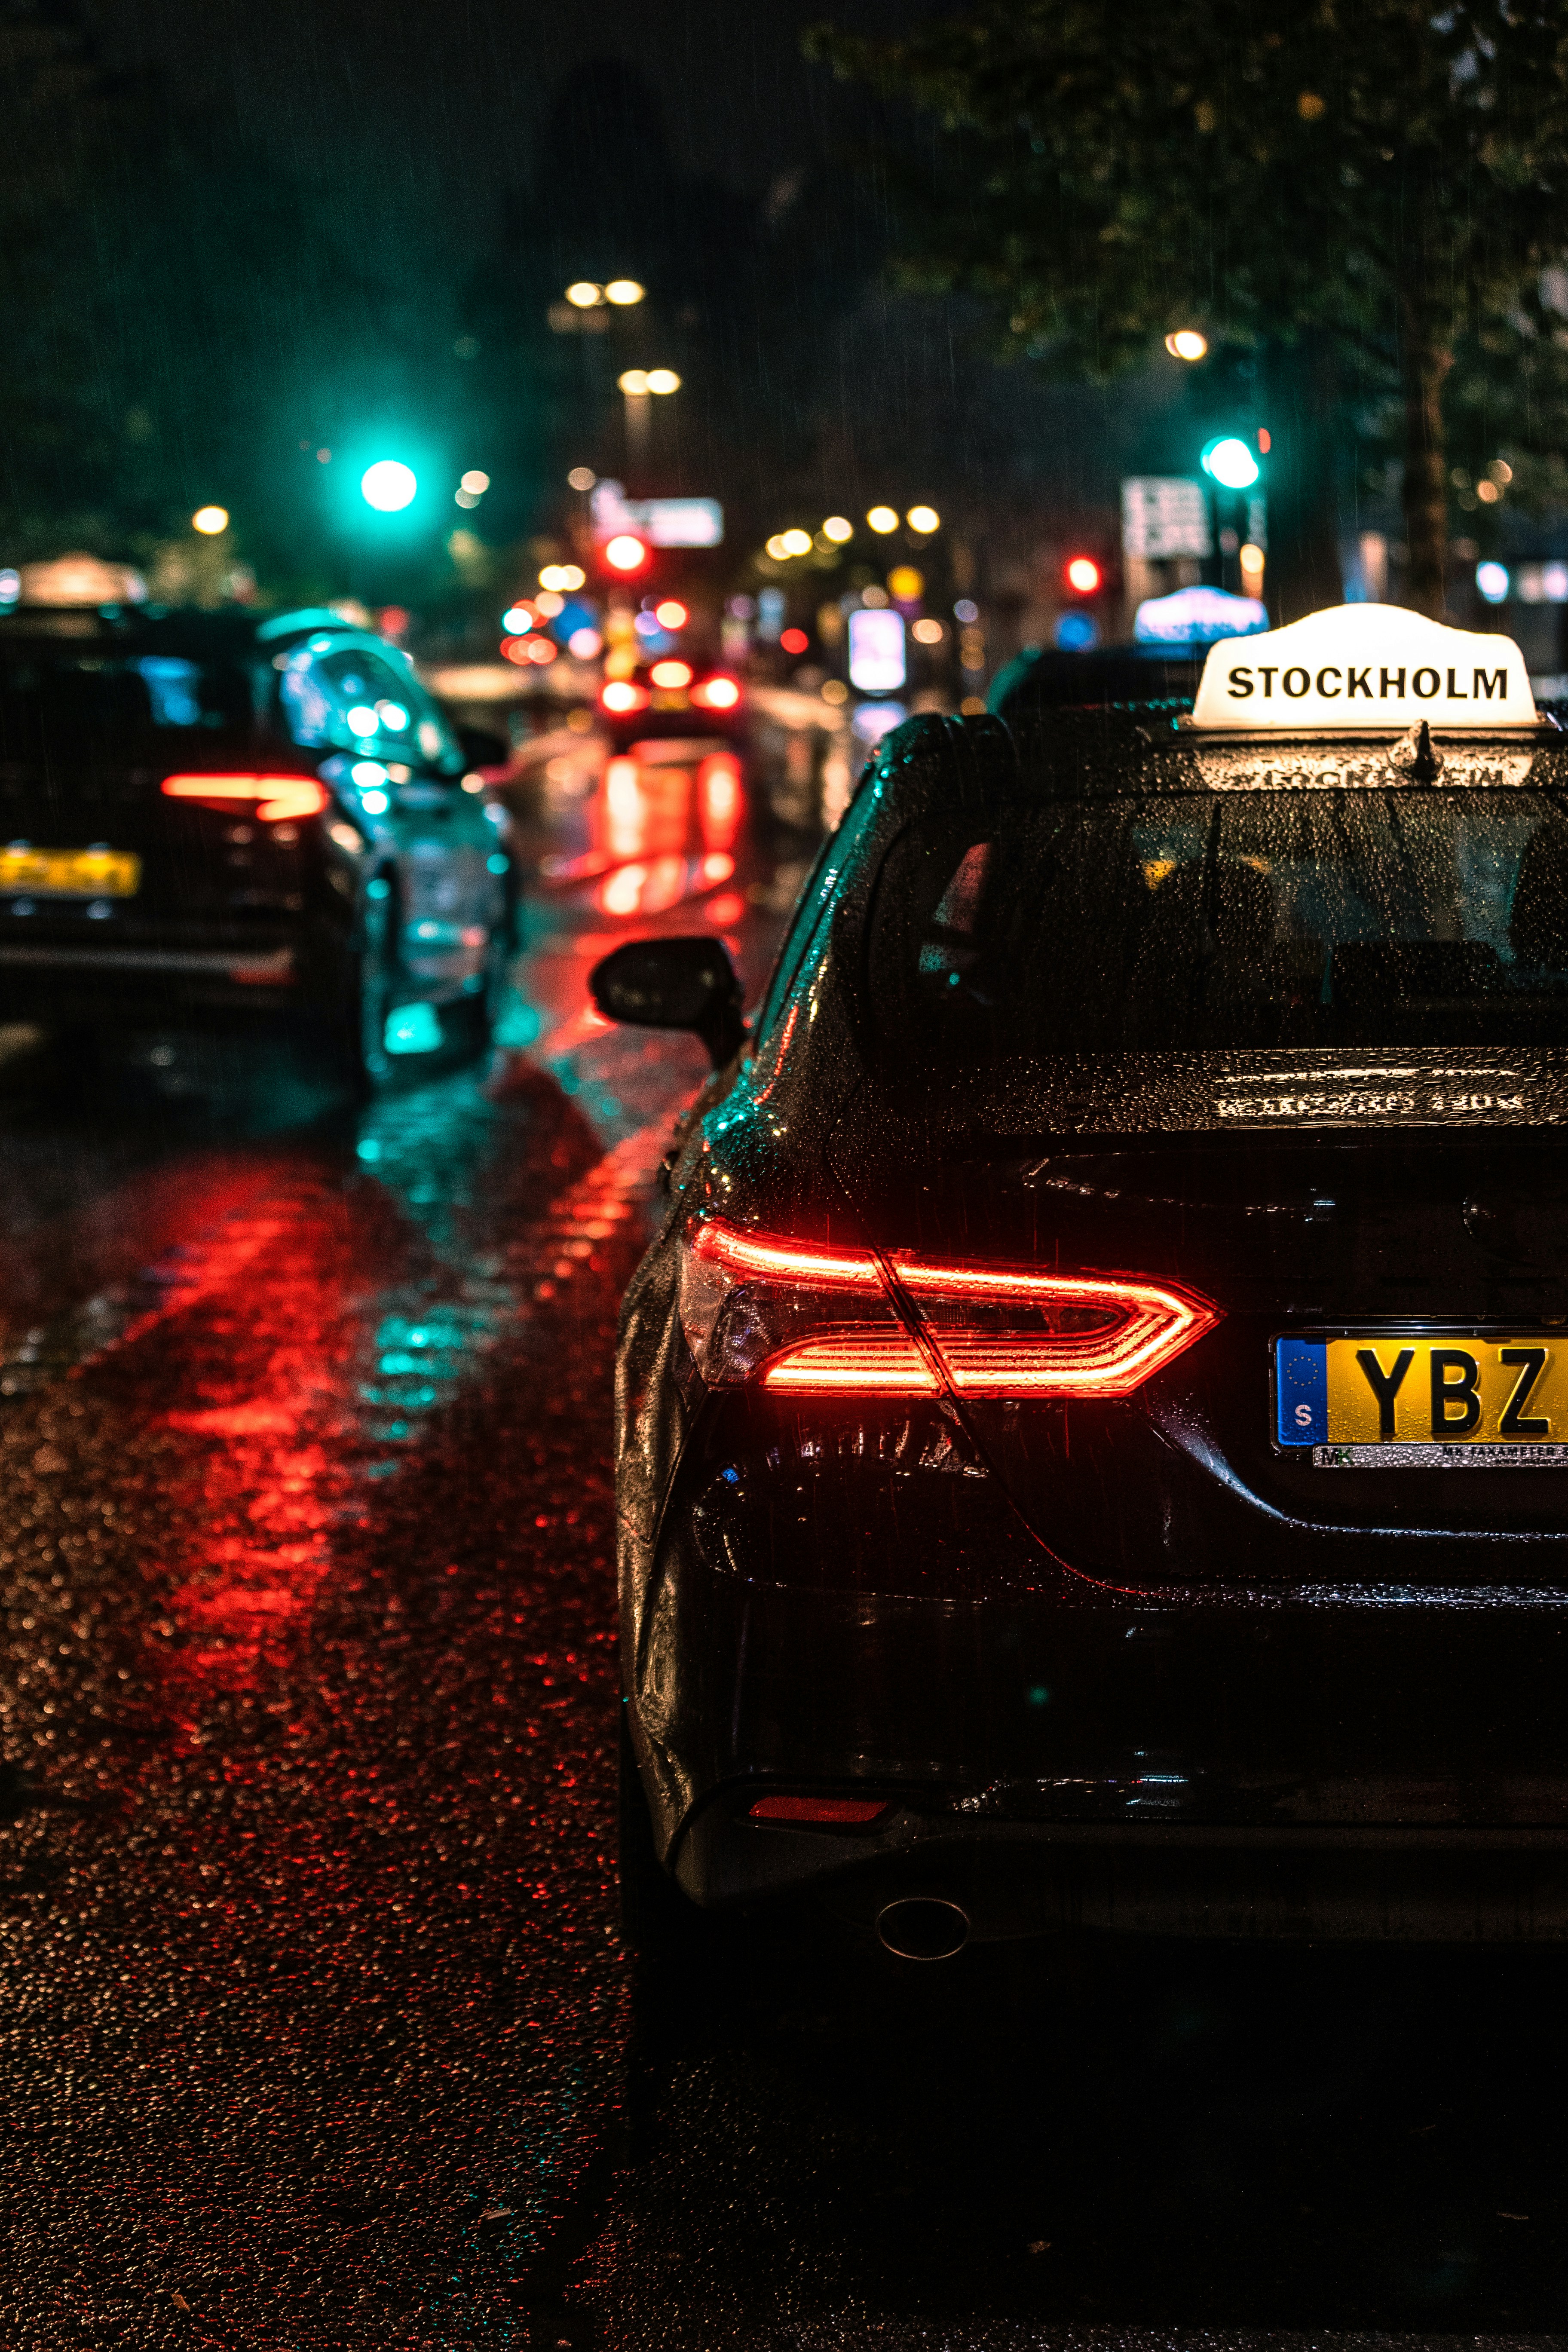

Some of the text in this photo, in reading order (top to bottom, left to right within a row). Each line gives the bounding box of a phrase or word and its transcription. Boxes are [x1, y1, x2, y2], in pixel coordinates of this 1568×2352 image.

[1227, 667, 1507, 700] STOCKHOLM
[1356, 1348, 1550, 1434] YBZ
[1295, 1404, 1312, 1426] S
[1321, 1447, 1354, 1465] MK
[1442, 1447, 1463, 1456] MK
[1470, 1447, 1555, 1456] TAXAMETER
